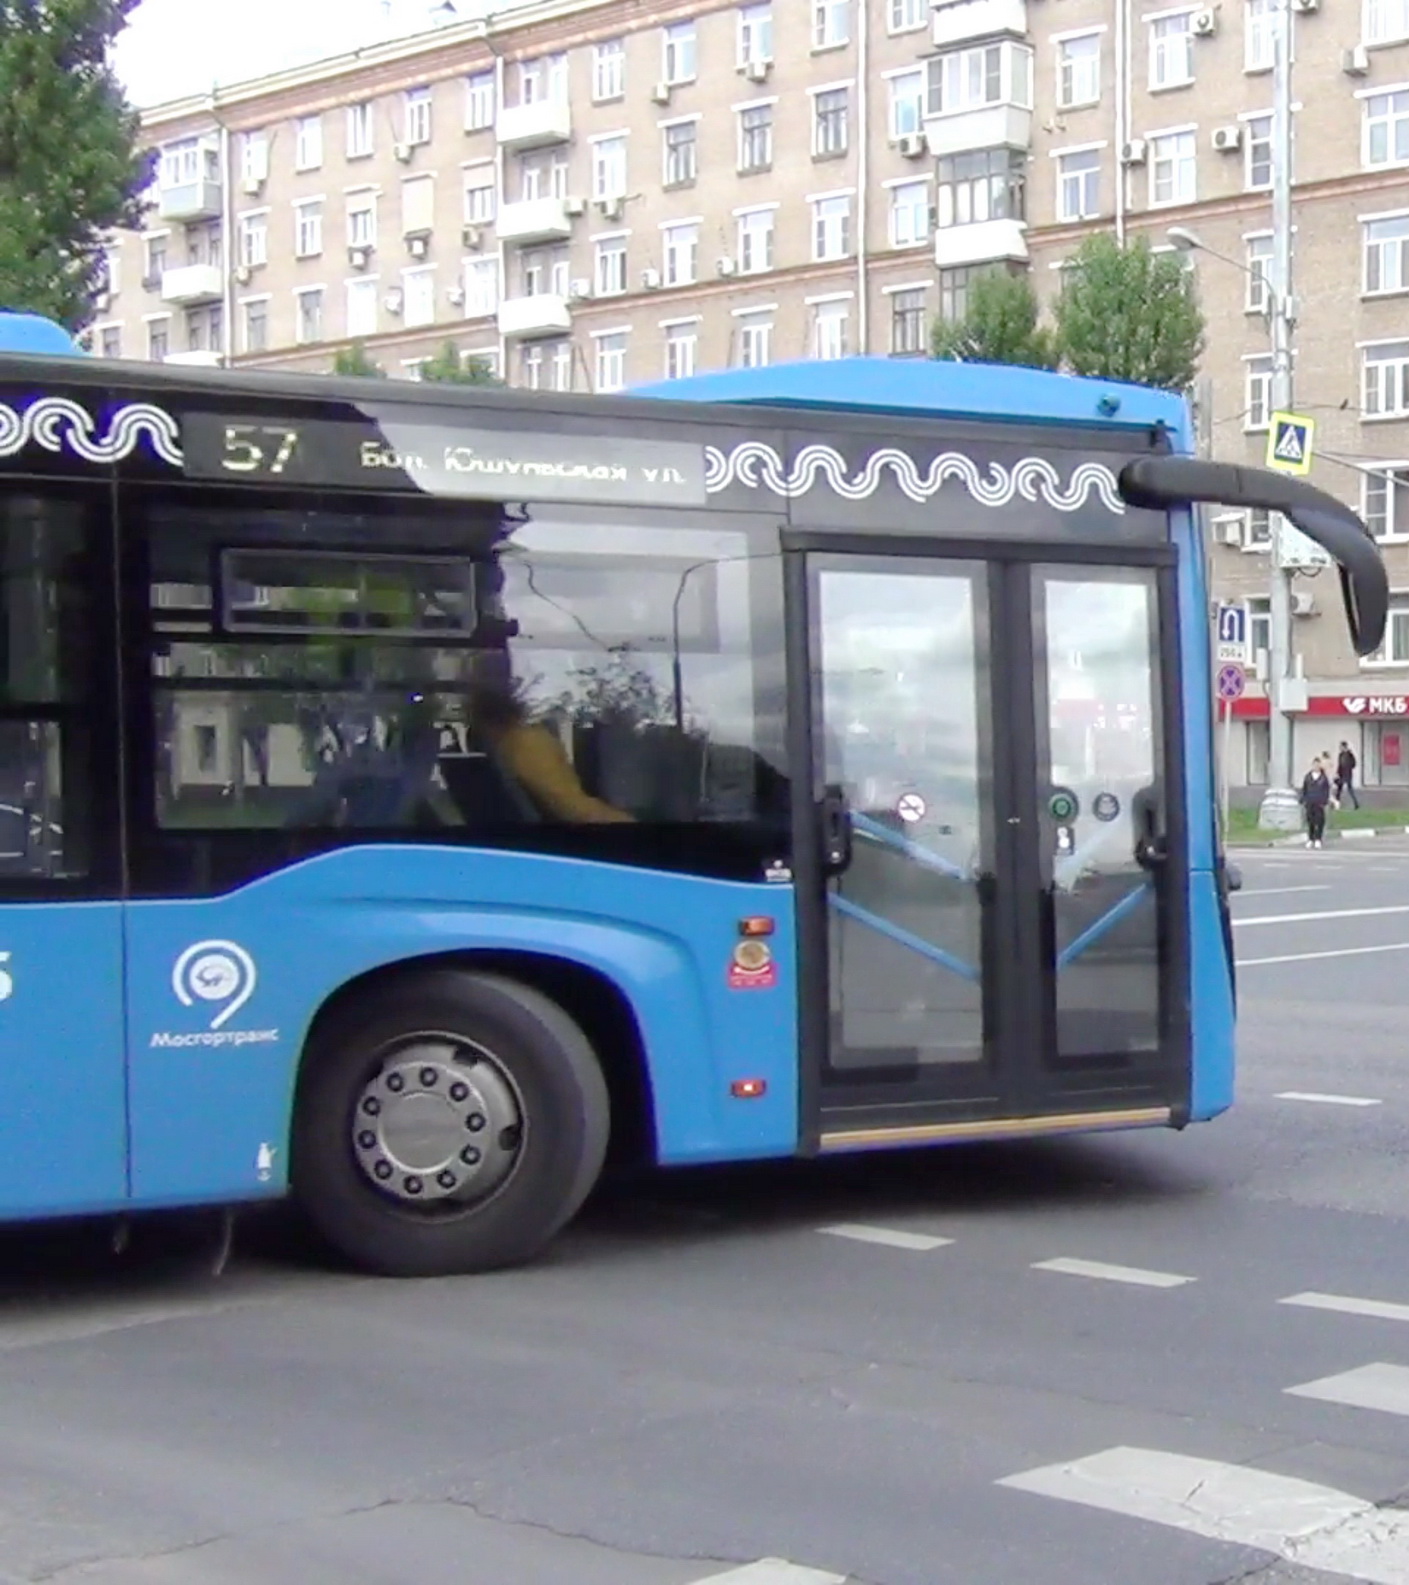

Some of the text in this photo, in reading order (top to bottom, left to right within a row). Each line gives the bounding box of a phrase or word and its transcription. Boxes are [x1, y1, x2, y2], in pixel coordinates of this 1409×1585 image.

[221, 424, 298, 473] 57
[1368, 696, 1409, 714] МКБ
[150, 1028, 279, 1049] Мосгортранс
